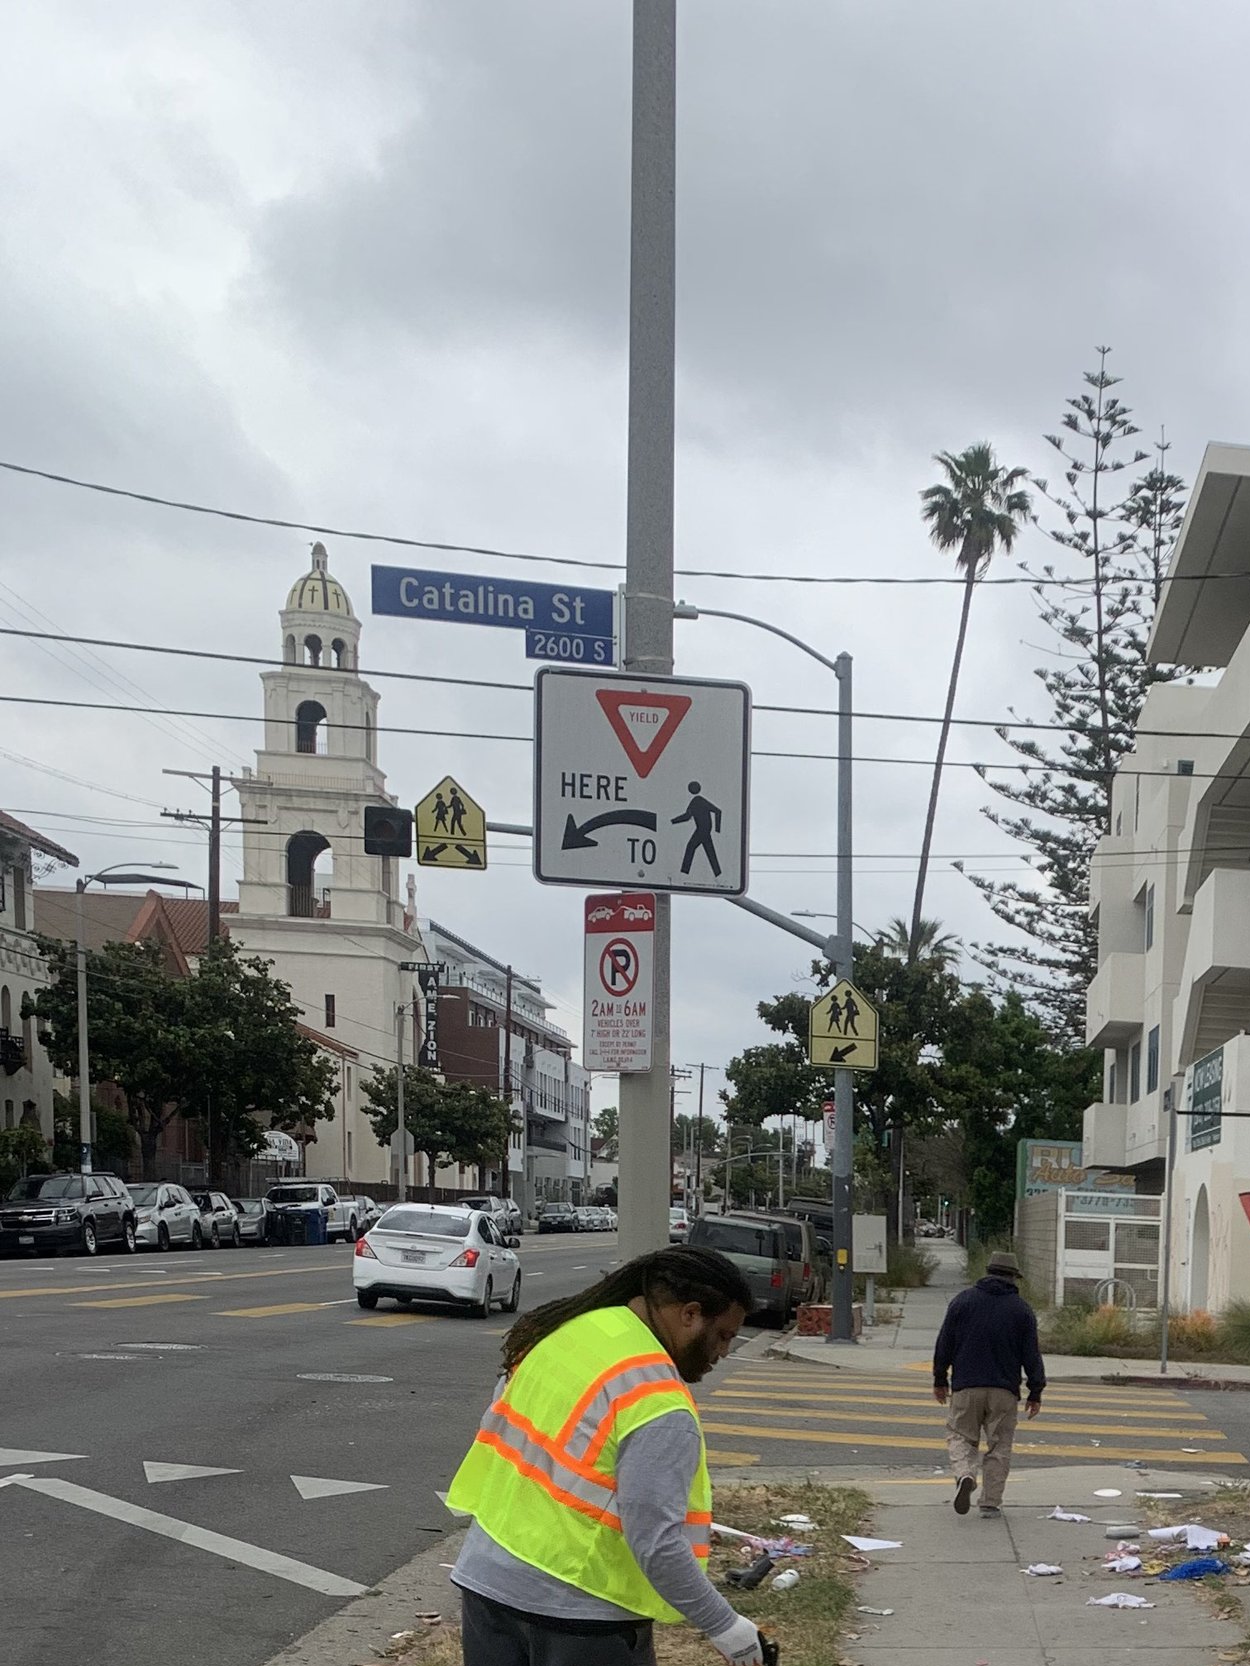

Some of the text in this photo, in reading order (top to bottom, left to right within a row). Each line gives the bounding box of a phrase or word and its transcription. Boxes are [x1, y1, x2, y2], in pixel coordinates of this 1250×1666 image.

[400, 576, 586, 625] Catalina St
[534, 634, 605, 661] 2600 S
[629, 711, 659, 724] YIELD
[561, 772, 628, 802] HERE
[627, 838, 657, 865] TO
[409, 963, 440, 972] FIRST
[591, 999, 614, 1017] 2AM
[624, 999, 646, 1017] 6AM
[625, 1019, 640, 1028] OVER
[631, 1029, 646, 1037] LONG
[427, 1020, 437, 1061] ZION
[1030, 1161, 1088, 1184] Auto
